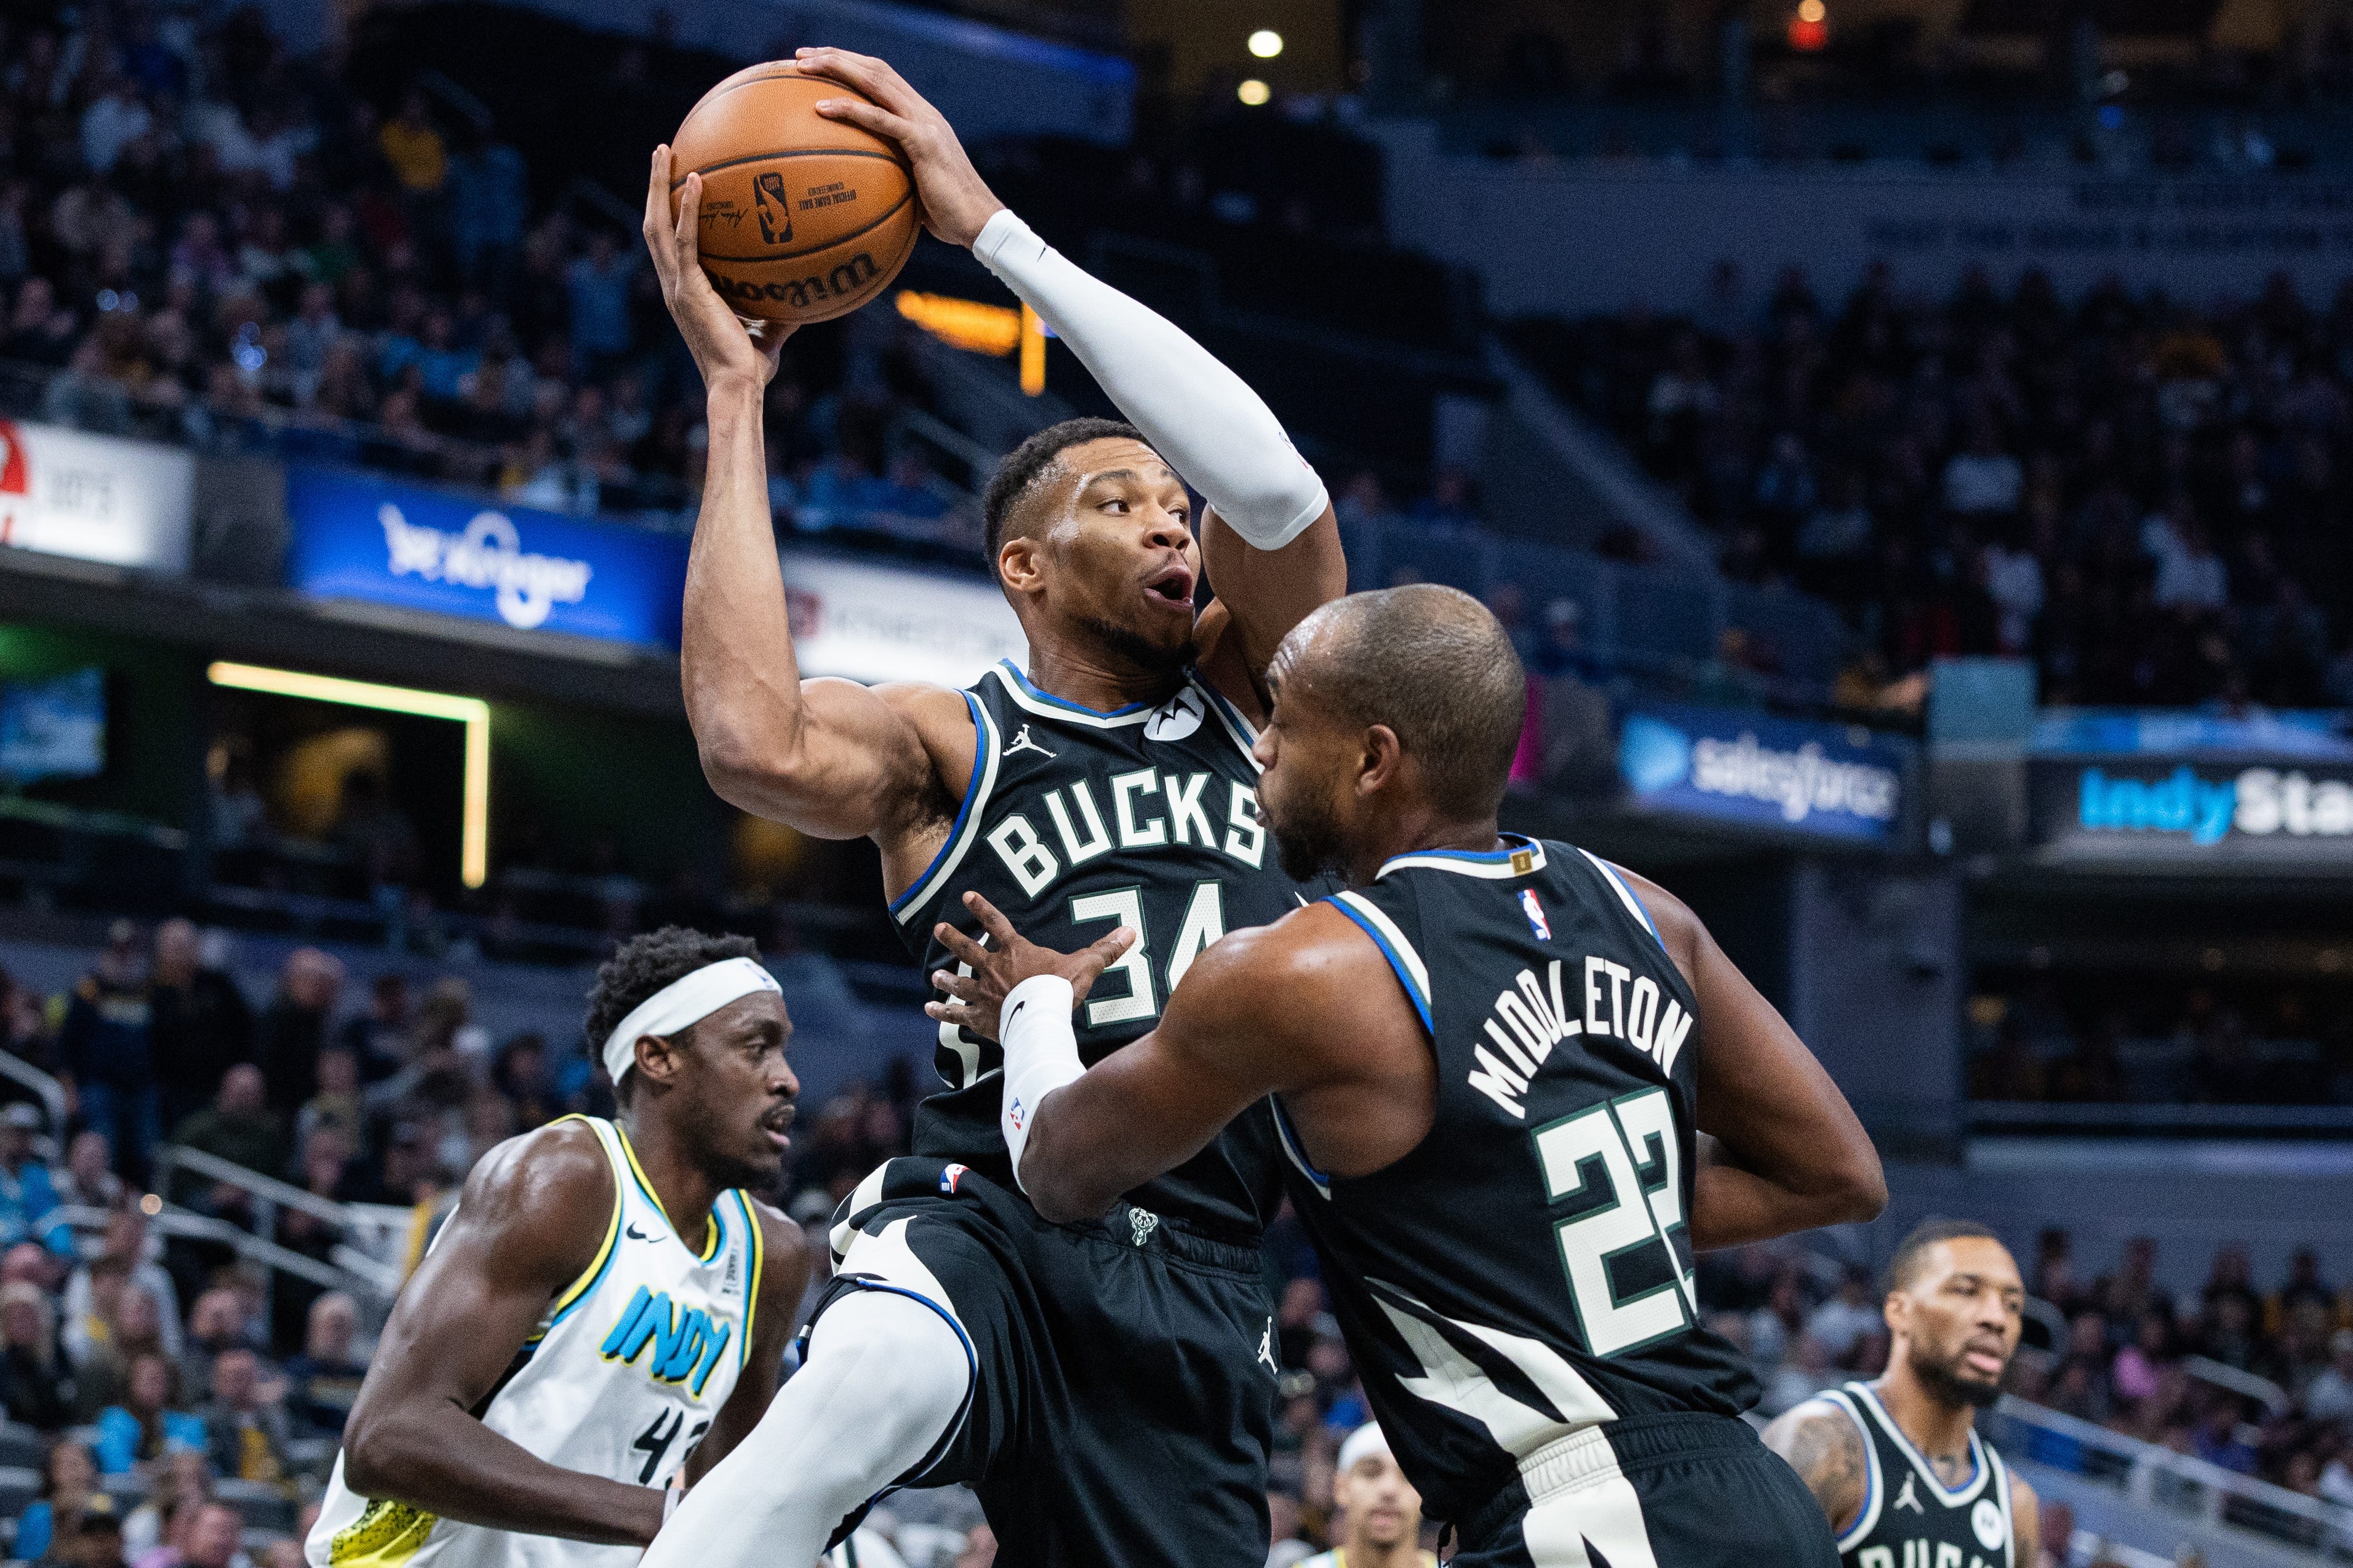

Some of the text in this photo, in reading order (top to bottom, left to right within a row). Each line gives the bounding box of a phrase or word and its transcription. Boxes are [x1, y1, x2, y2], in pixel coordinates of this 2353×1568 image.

[798, 189, 857, 211] OFFICIAL GAME BALL
[986, 766, 1266, 901] BUCKS
[2079, 766, 2353, 847] IndySta
[1068, 878, 1227, 1029] 34
[1468, 955, 1693, 1120] MIDDLETON
[1530, 1085, 1698, 1357] 22
[597, 1284, 732, 1401] INDY
